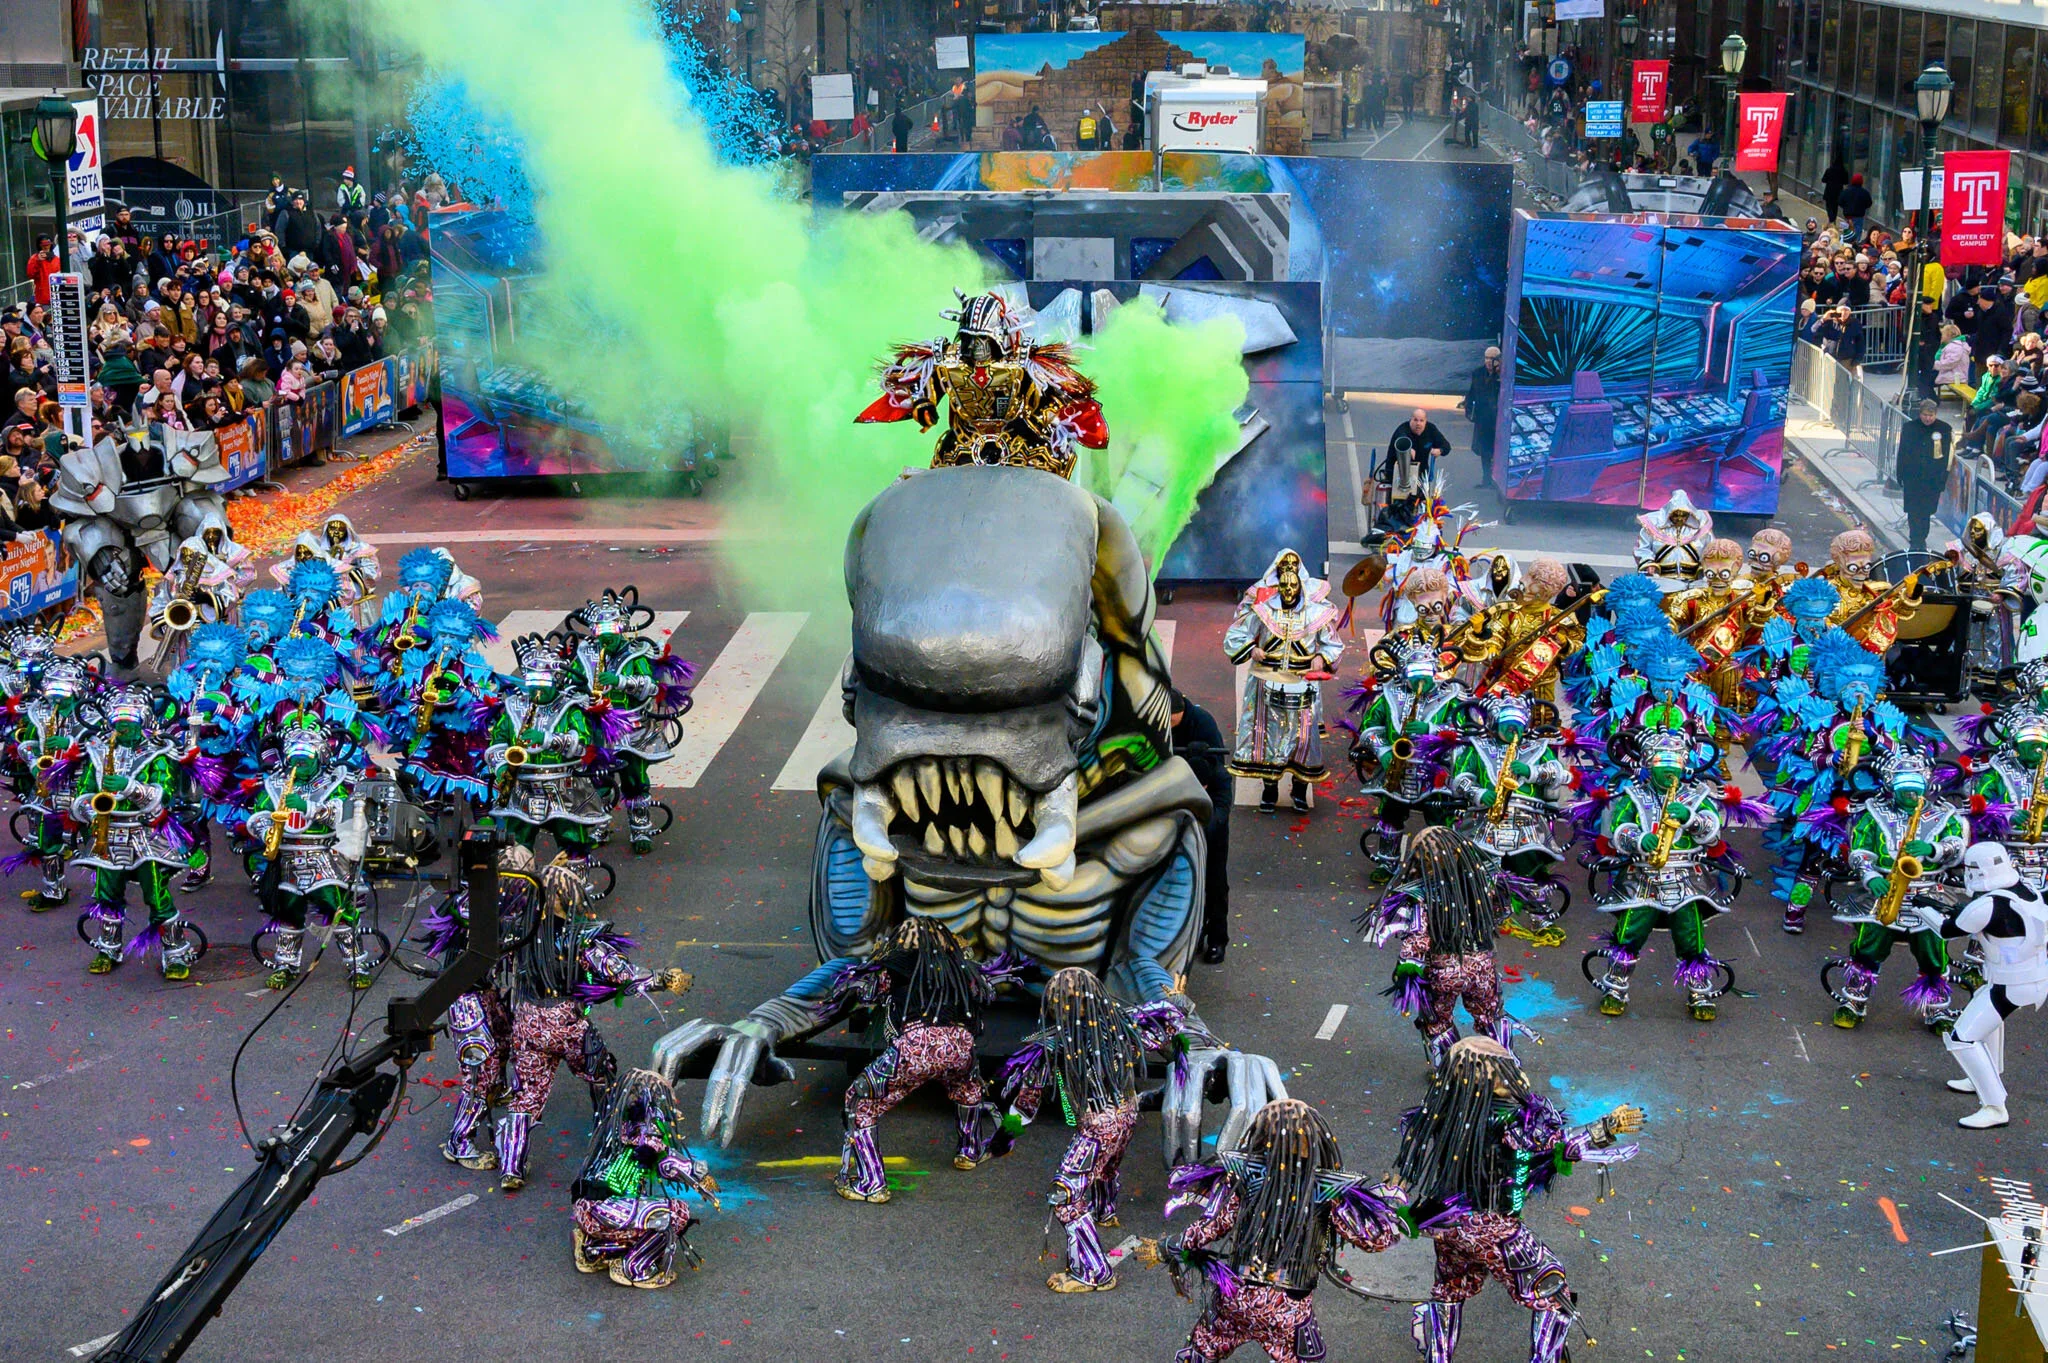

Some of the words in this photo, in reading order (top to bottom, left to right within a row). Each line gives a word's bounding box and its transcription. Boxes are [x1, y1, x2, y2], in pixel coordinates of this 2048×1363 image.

[82, 47, 177, 70] RETAIL
[86, 74, 162, 97] SPACE
[101, 97, 226, 119] VAILABLE
[1187, 111, 1238, 128] Ryder
[70, 173, 100, 195] SEPTA
[51, 284, 60, 292] 17
[52, 292, 61, 300] 31
[52, 301, 61, 309] 32
[53, 309, 63, 317] 33
[57, 359, 70, 367] 124
[57, 368, 70, 376] 125
[24, 538, 45, 556] Night
[2, 562, 20, 574] Every
[20, 554, 39, 569] Night!
[12, 575, 30, 595] PHL
[21, 589, 29, 605] 17
[45, 589, 62, 603] MOM
